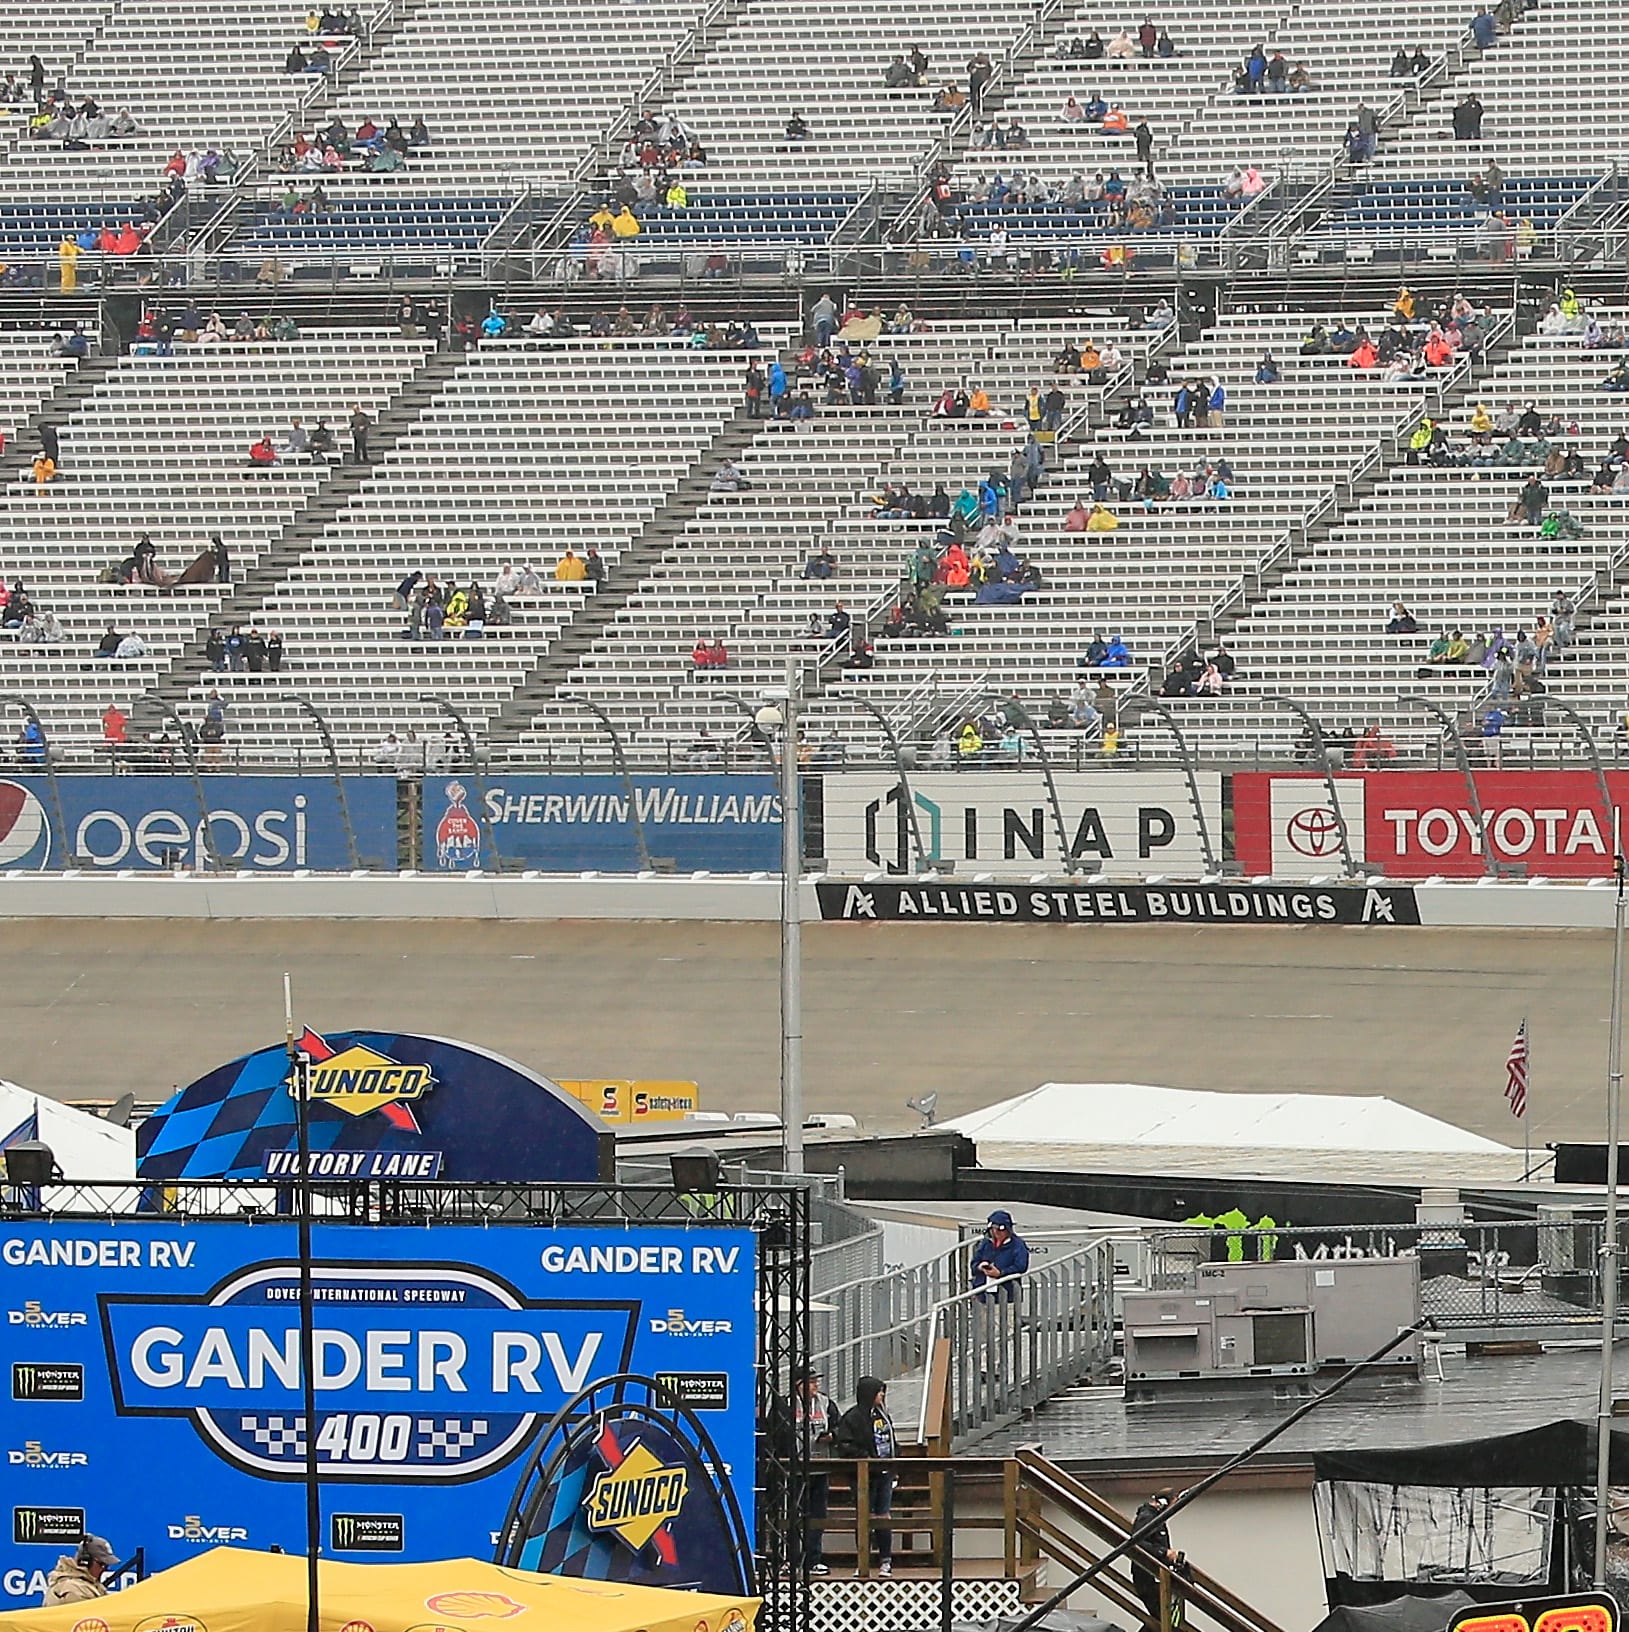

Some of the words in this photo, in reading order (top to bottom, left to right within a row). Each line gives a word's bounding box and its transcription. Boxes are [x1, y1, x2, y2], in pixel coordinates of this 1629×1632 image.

[481, 788, 630, 824] SHERWIN
[634, 787, 786, 824] WILLIAMS
[964, 806, 1176, 860] INAP
[1384, 807, 1607, 855] TOYOTA
[897, 891, 1018, 917] ALLIED
[1031, 892, 1136, 918] STEEL
[1149, 893, 1338, 919] BUILDINGS
[306, 1068, 423, 1094] SUNOCO
[370, 1153, 435, 1176] LANE
[2, 1239, 141, 1267] GANDER
[541, 1245, 682, 1273] GANDER
[309, 1288, 398, 1301] NTERNATIONAL
[404, 1289, 465, 1302] SPEEDWAY
[131, 1326, 468, 1392] GANDER
[492, 1331, 602, 1394] RV
[315, 1414, 413, 1462] 400
[595, 1475, 685, 1525] SUNOCO
